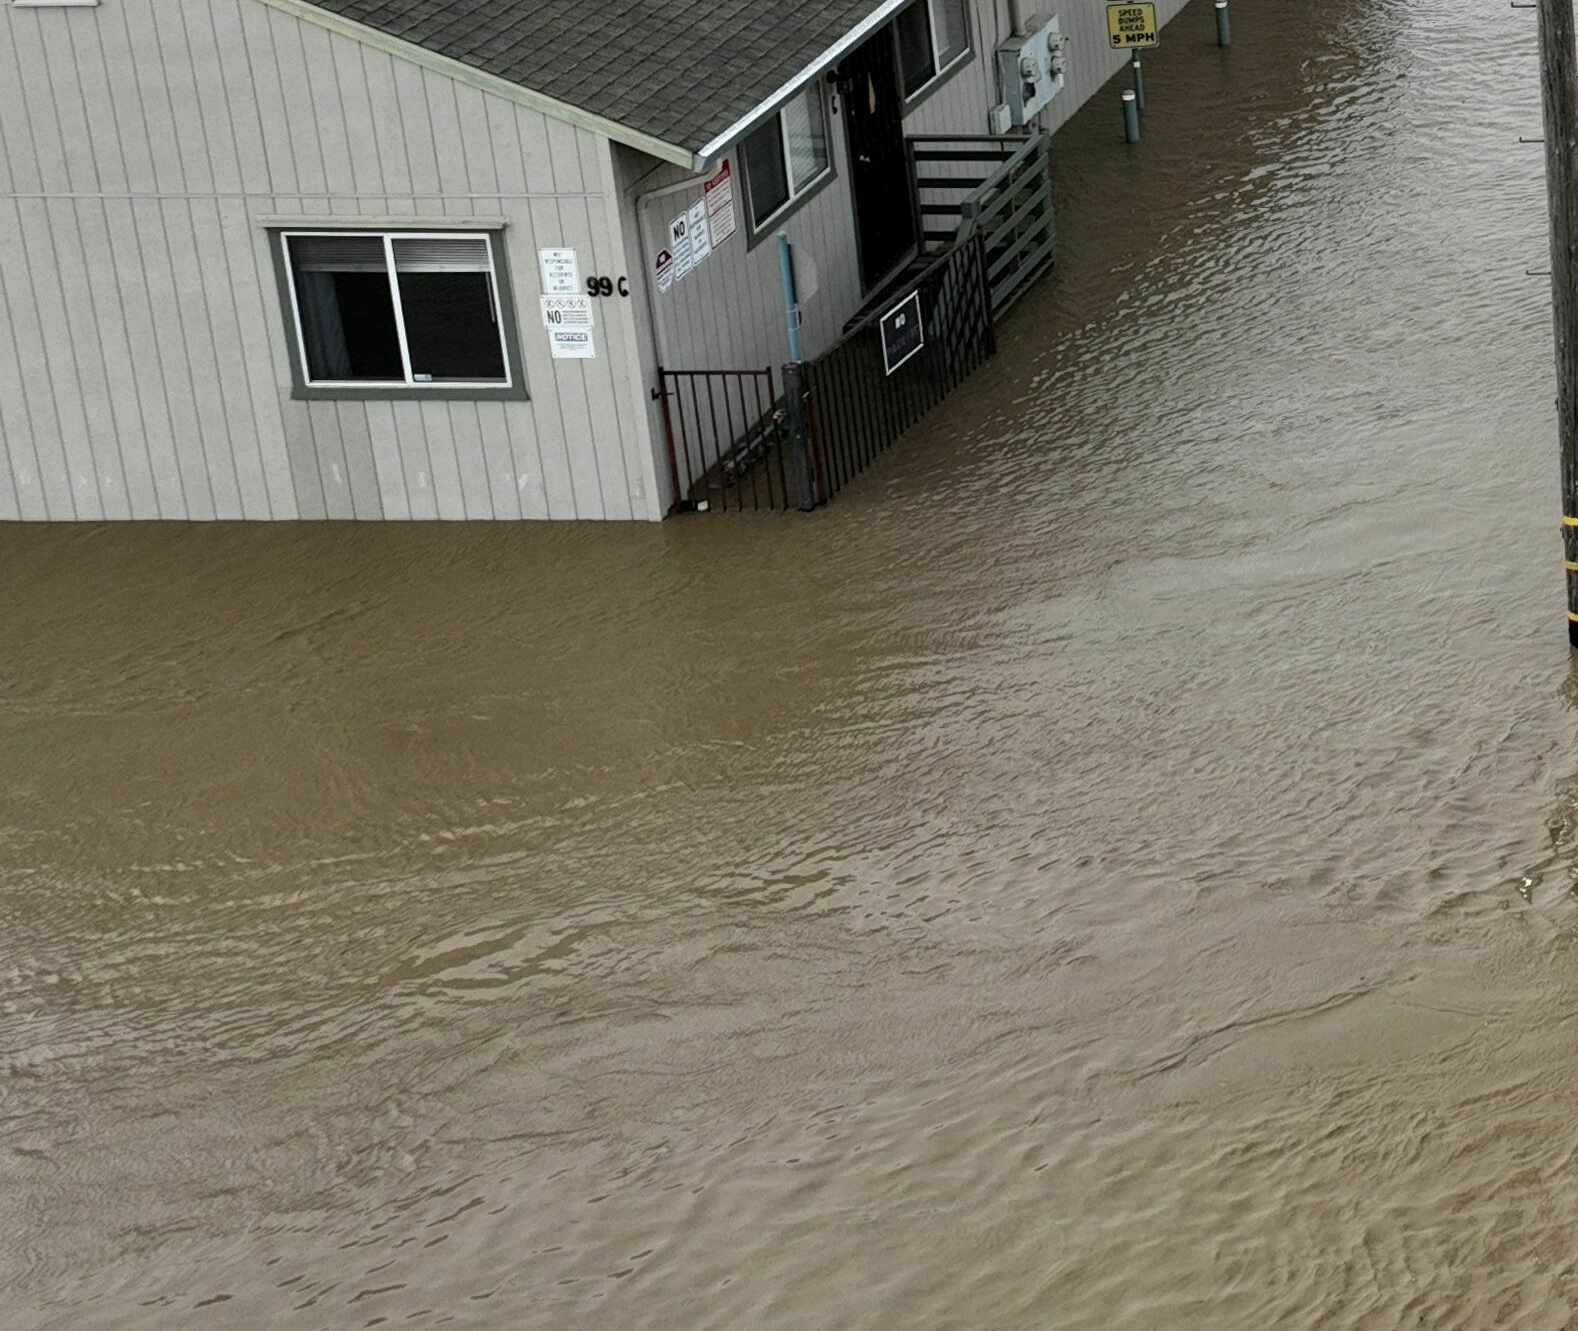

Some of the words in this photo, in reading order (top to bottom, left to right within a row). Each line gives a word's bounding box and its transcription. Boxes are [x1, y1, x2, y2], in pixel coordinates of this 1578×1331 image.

[1118, 9, 1142, 17] SPEED
[1118, 17, 1144, 25] BUMPS
[1112, 35, 1120, 44] 5
[1126, 33, 1154, 42] MPH
[674, 221, 685, 241] NO
[586, 277, 613, 297] 99
[547, 310, 561, 324] NO
